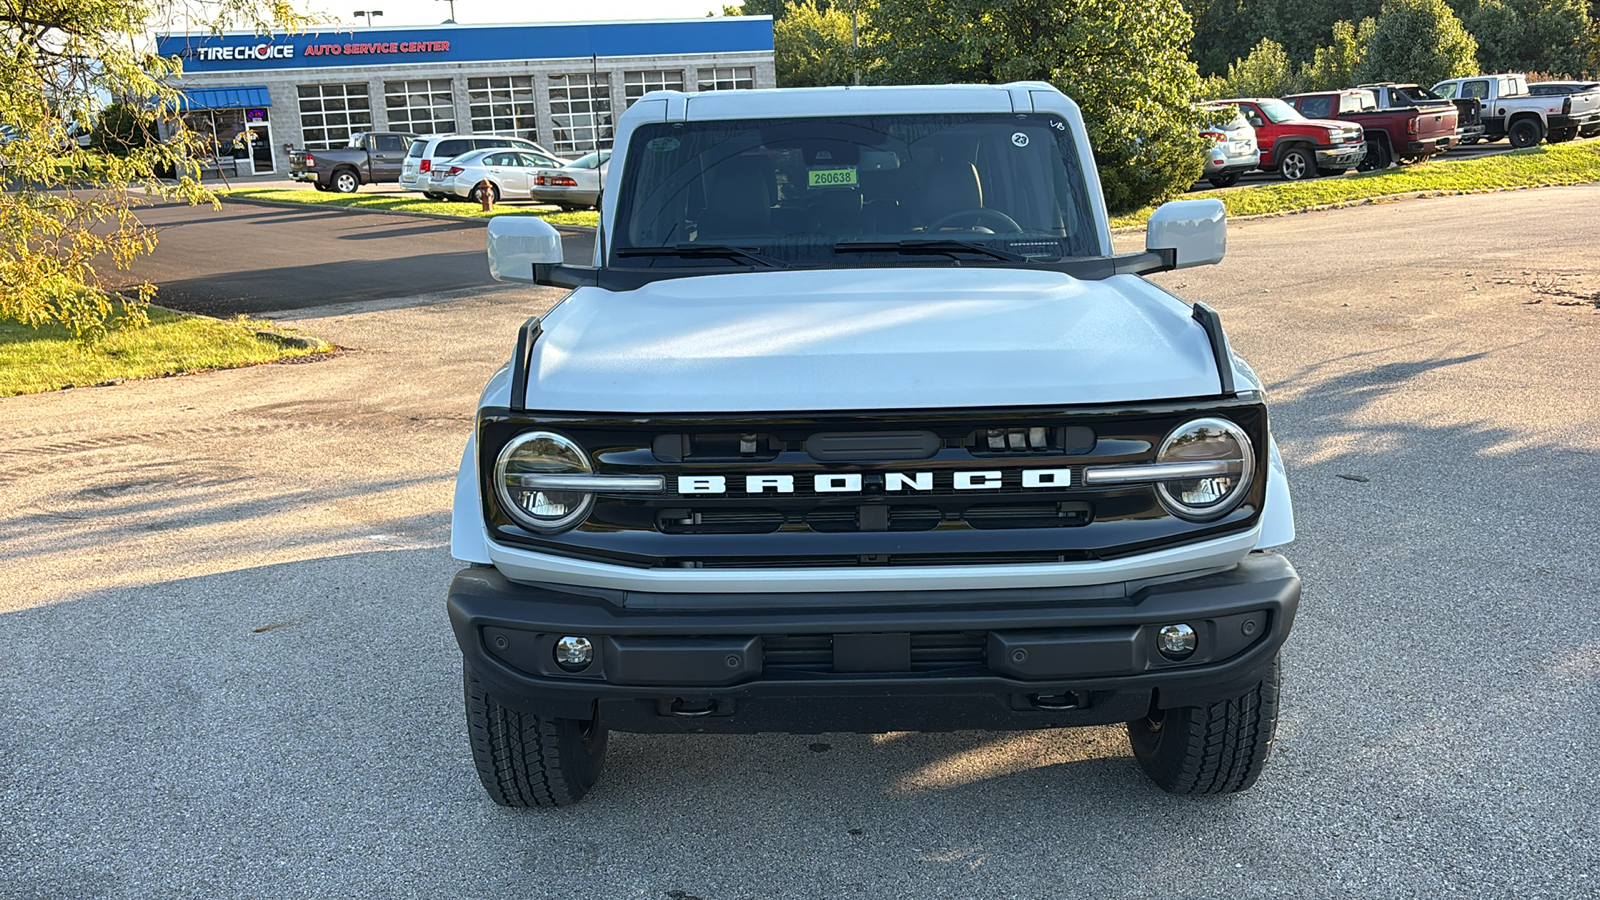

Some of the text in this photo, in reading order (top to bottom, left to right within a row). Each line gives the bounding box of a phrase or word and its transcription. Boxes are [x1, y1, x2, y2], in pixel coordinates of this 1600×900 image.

[304, 41, 450, 56] AUTO SERVICE CENTER
[814, 172, 851, 184] 260638
[678, 469, 1071, 494] BRONCO
